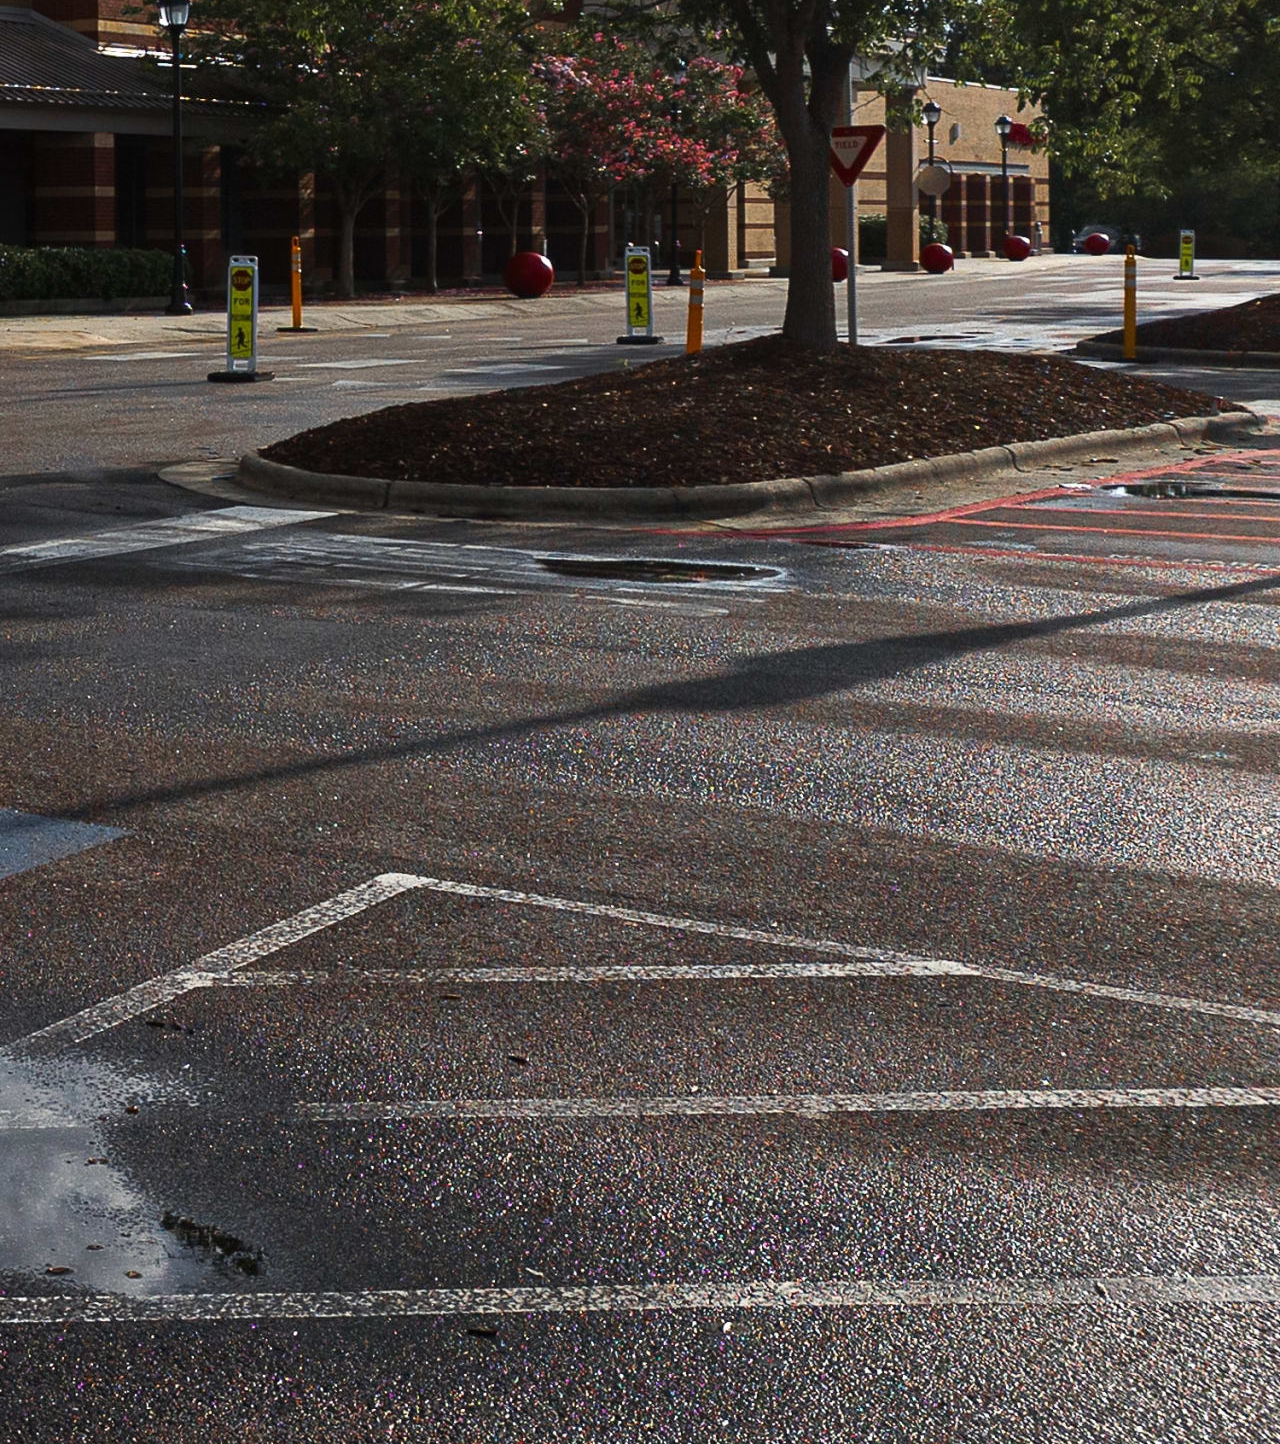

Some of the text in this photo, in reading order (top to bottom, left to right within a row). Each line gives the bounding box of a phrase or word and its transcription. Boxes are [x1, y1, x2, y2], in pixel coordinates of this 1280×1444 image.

[834, 140, 858, 148] YIELD
[232, 276, 251, 285] STOP
[233, 297, 250, 306] FOR
